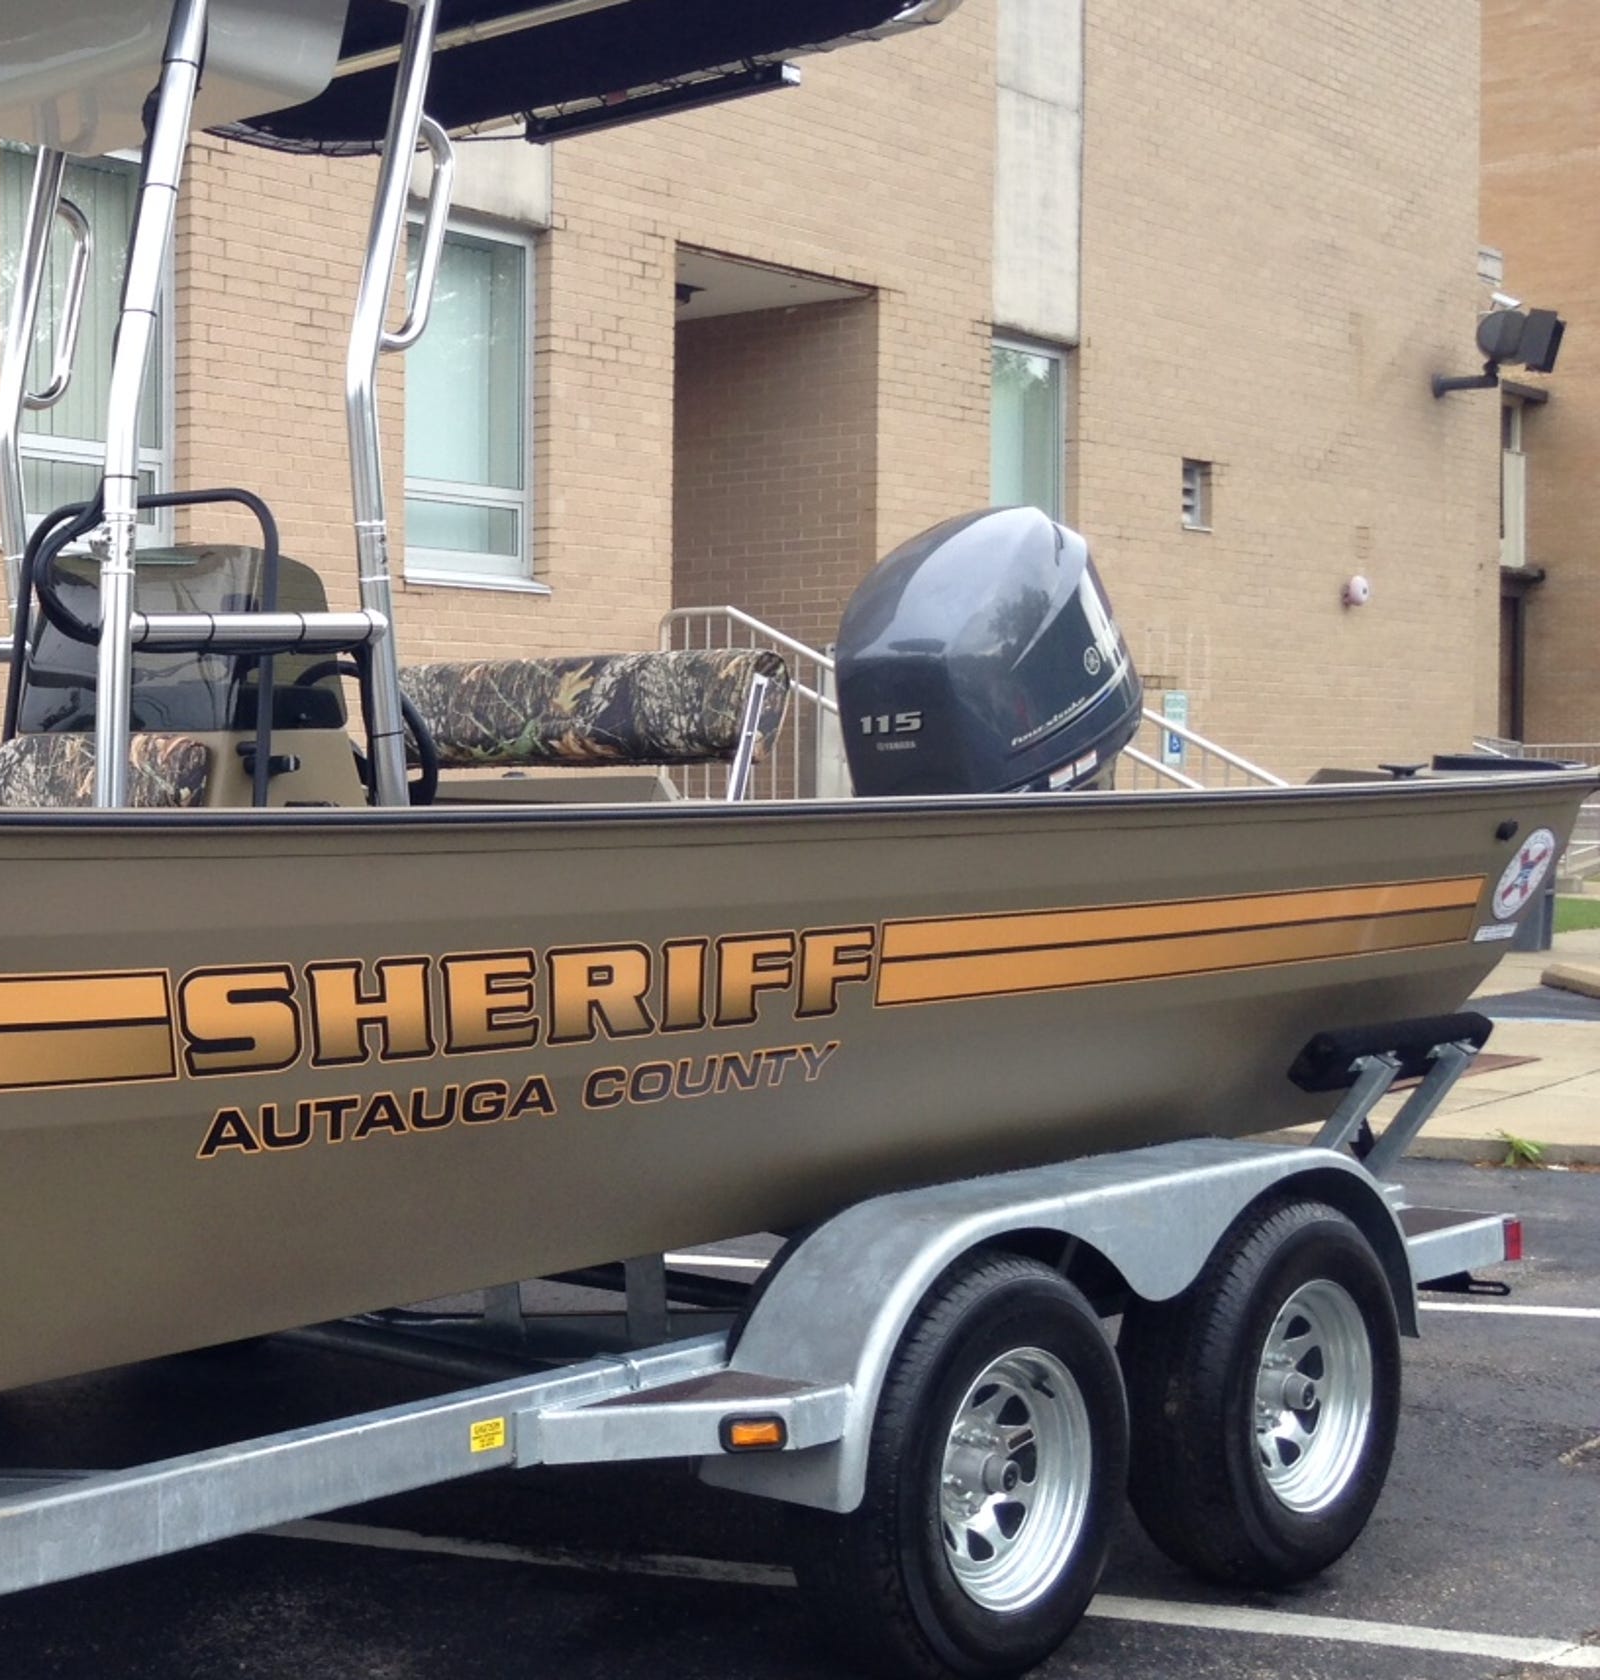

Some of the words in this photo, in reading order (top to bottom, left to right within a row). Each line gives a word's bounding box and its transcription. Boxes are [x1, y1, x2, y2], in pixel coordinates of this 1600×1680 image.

[860, 711, 922, 734] 115
[178, 922, 877, 1079] SHERIFF
[196, 1074, 558, 1160] AUTAUGA
[581, 1039, 841, 1110] COUNTY
